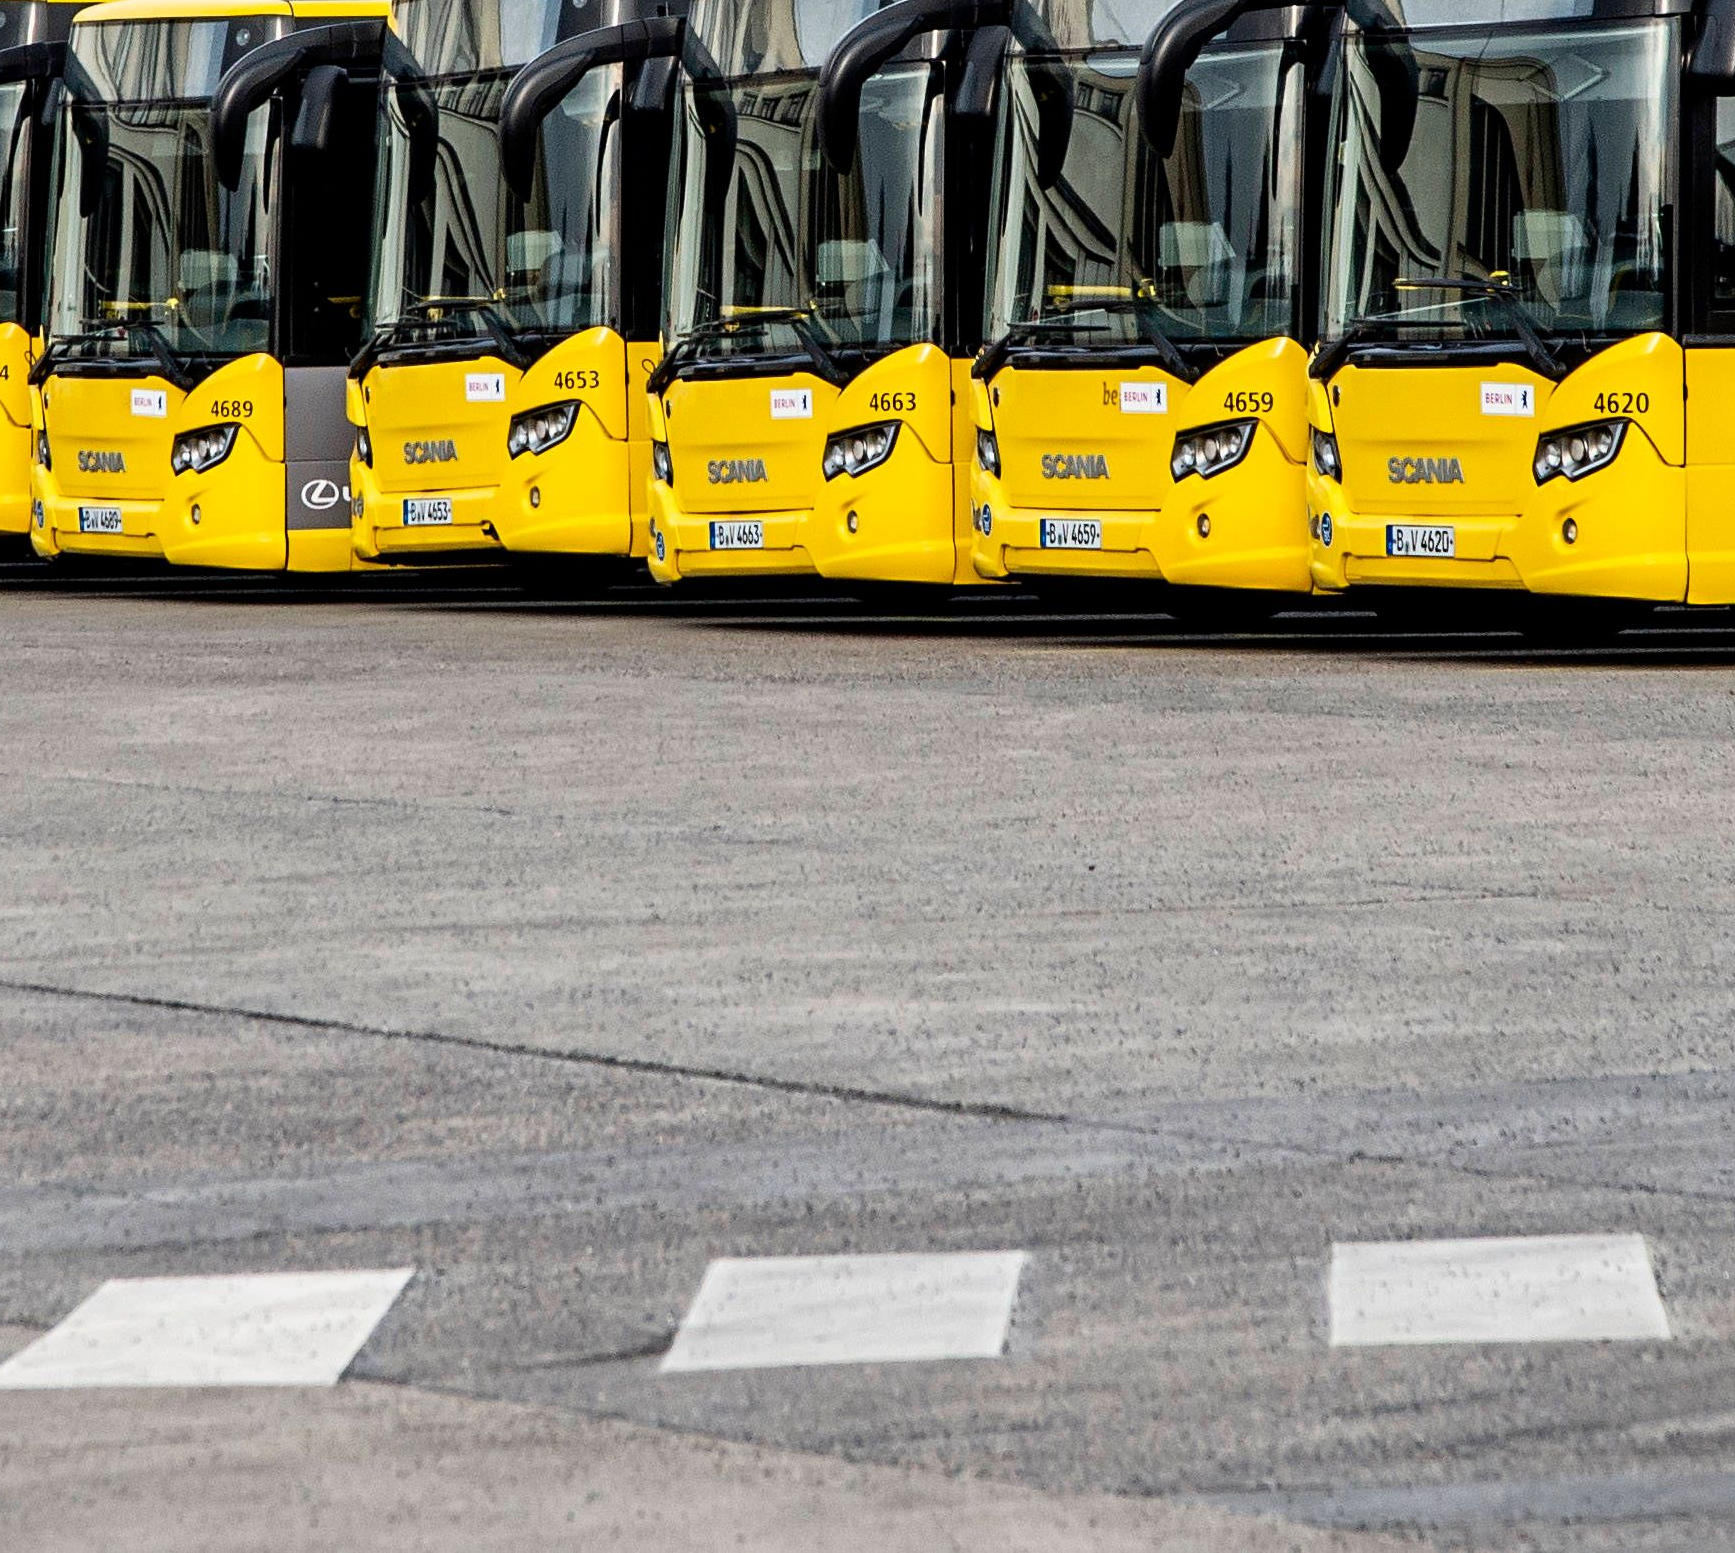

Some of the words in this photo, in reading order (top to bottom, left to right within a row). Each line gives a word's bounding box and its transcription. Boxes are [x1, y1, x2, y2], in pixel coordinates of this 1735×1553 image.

[468, 382, 489, 393] BERLIN
[554, 370, 600, 389] 4653
[773, 398, 796, 409] BERLIN
[869, 392, 917, 412] 4663
[1124, 391, 1148, 403] BERLIN
[1223, 392, 1274, 413] 4659
[1485, 392, 1513, 406] BERLIN
[1593, 392, 1650, 414] 4620
[210, 399, 254, 418] 4689
[78, 449, 126, 473] SCANIA
[403, 439, 458, 464] SCANIA
[707, 458, 769, 484] SCANIA
[1041, 454, 1110, 480] SCANIA
[1387, 456, 1465, 484] SCANIA
[737, 524, 760, 546] 4663
[1071, 523, 1097, 546] 4659
[1421, 530, 1450, 553] 4620
